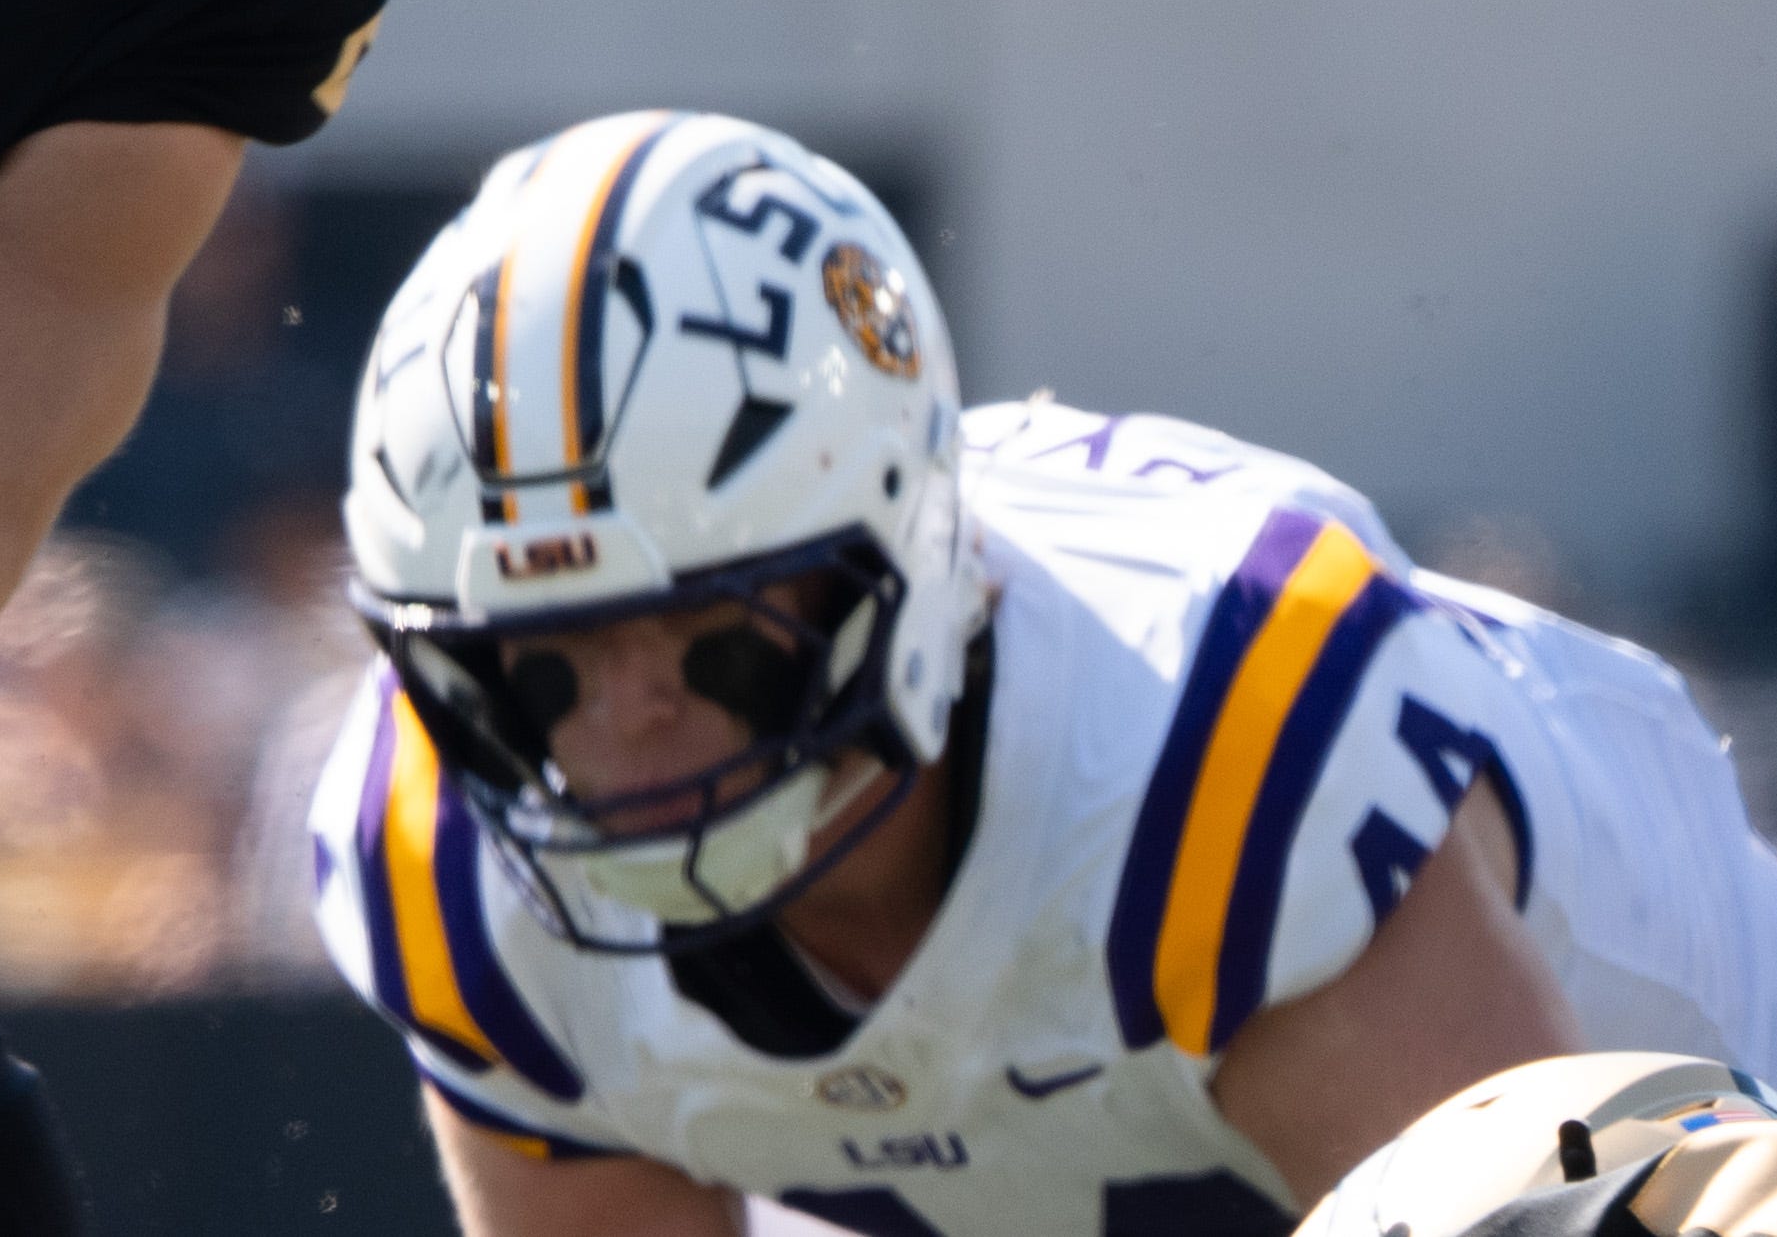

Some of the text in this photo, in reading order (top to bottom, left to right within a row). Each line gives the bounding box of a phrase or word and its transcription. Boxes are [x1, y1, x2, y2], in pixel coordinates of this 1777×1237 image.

[679, 164, 822, 362] 57
[494, 532, 597, 580] LSU
[840, 1131, 971, 1171] LSU
